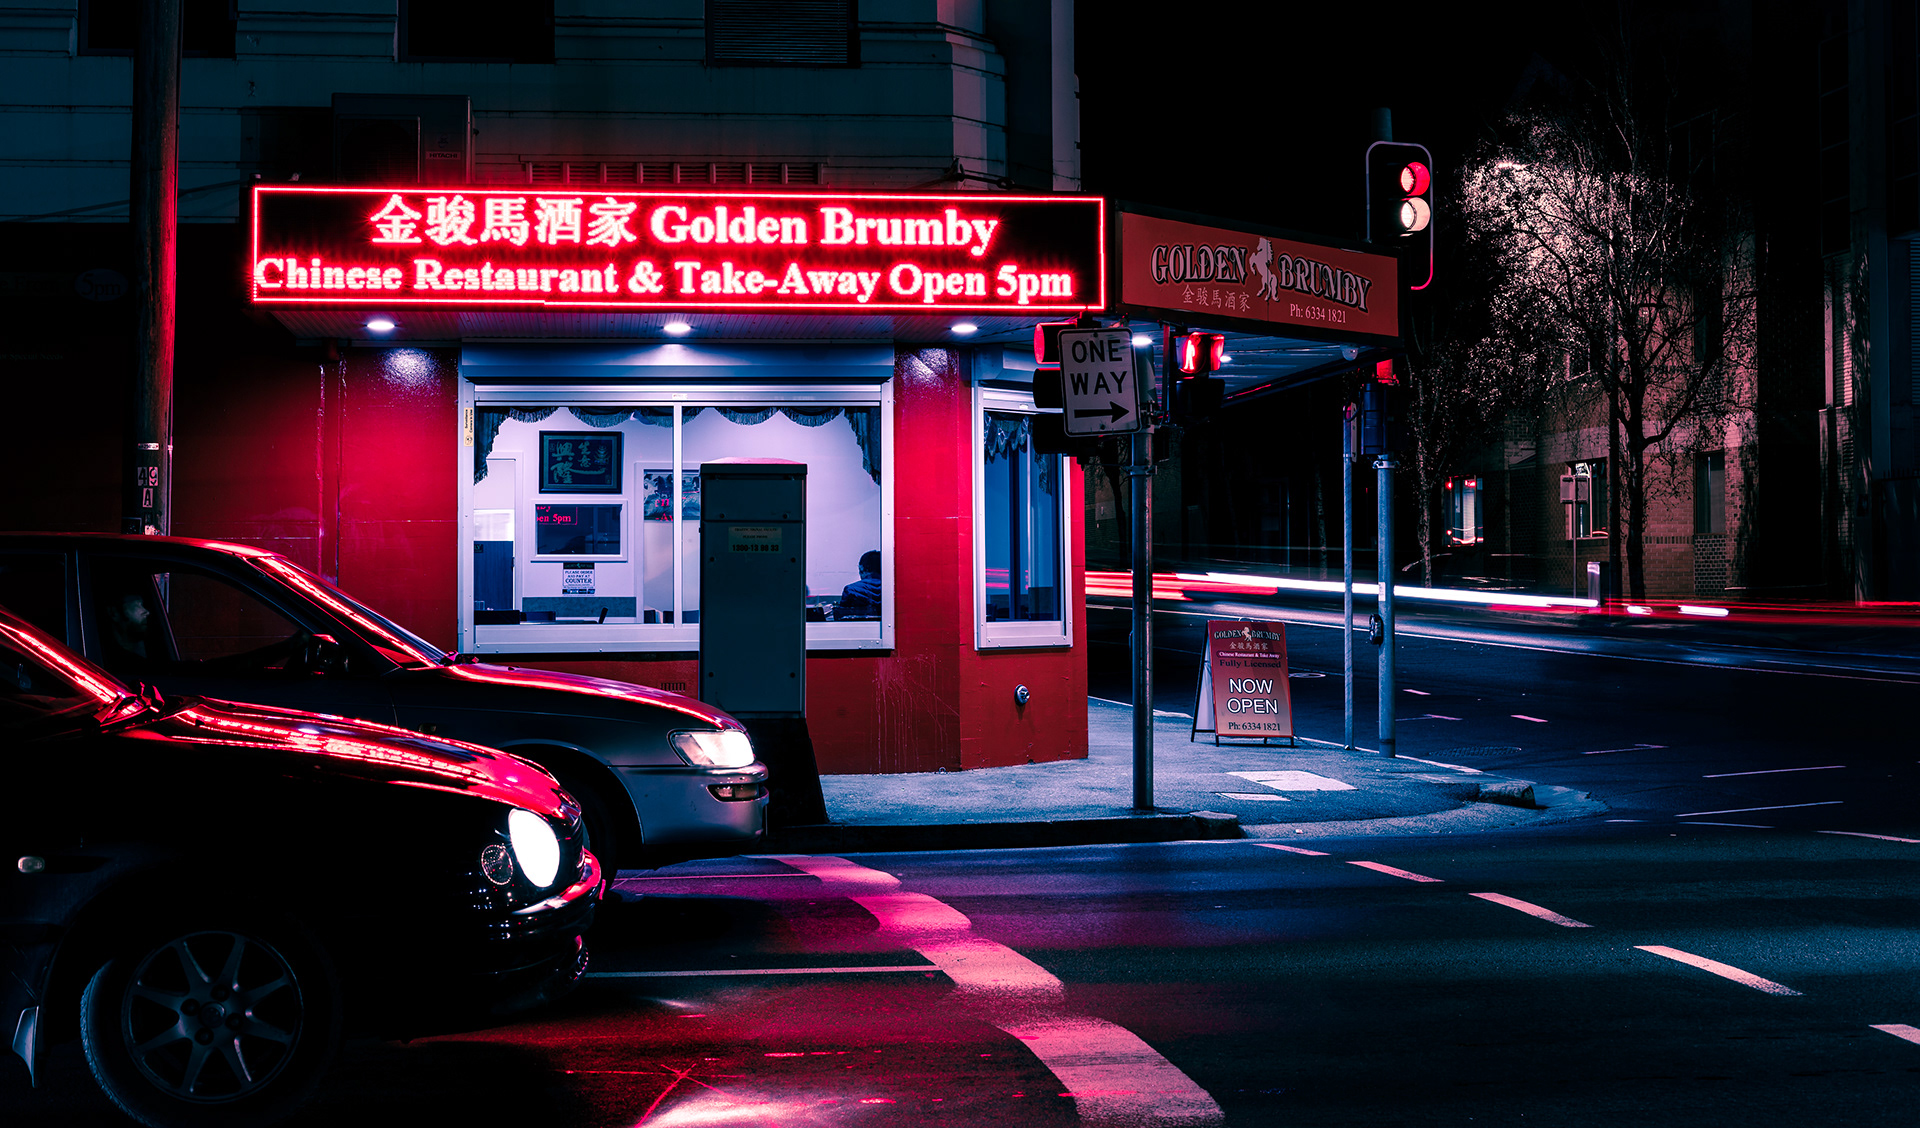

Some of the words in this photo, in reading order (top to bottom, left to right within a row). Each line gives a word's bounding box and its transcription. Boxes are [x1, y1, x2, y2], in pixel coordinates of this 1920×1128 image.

[650, 205, 808, 245] Golden
[819, 207, 999, 257] Brumby
[255, 258, 402, 290] Chinese
[413, 259, 619, 293] Restaurant
[628, 261, 664, 294] &
[674, 261, 881, 303] Take-Away
[889, 264, 986, 304] Open
[996, 265, 1073, 305] 5pm
[1151, 244, 1248, 284] GOLDEN
[1277, 252, 1372, 313] BRUMBY
[1290, 304, 1304, 318] Ph:
[1305, 306, 1326, 321] 6334
[1327, 309, 1347, 324] 1821
[1071, 339, 1123, 363] ONE
[1070, 370, 1128, 396] WAY
[1214, 629, 1242, 640] GOLDEN
[1251, 630, 1281, 641] BRUMBY
[1220, 660, 1241, 669] Fully
[1244, 660, 1281, 668] Licensed
[1229, 678, 1273, 694] NOW
[1227, 698, 1278, 714] OPEN
[1228, 722, 1241, 730] Ph:
[1242, 723, 1261, 731] 6334
[1263, 723, 1280, 731] 1821
